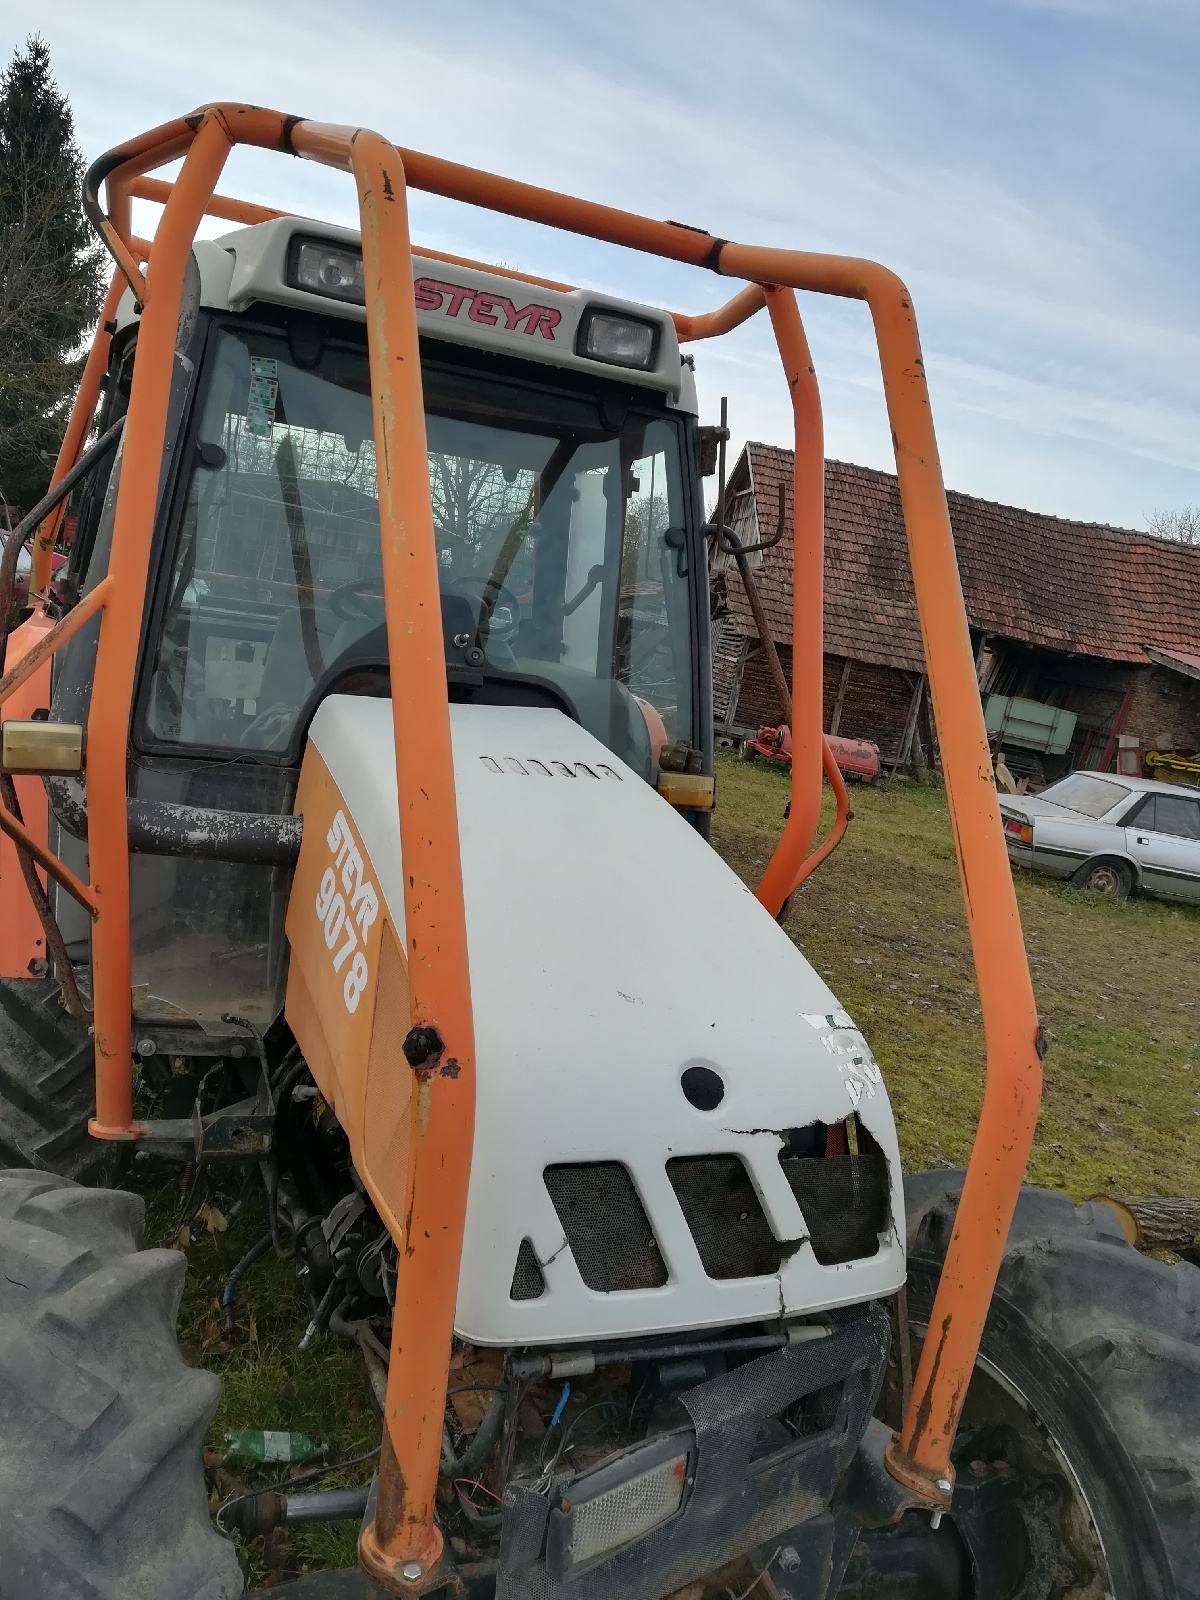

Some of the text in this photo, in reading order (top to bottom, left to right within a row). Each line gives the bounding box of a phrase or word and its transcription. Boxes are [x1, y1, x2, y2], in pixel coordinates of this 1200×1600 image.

[414, 277, 562, 340] STEYR
[316, 867, 368, 1014] 9078
[326, 809, 379, 945] STEYR
